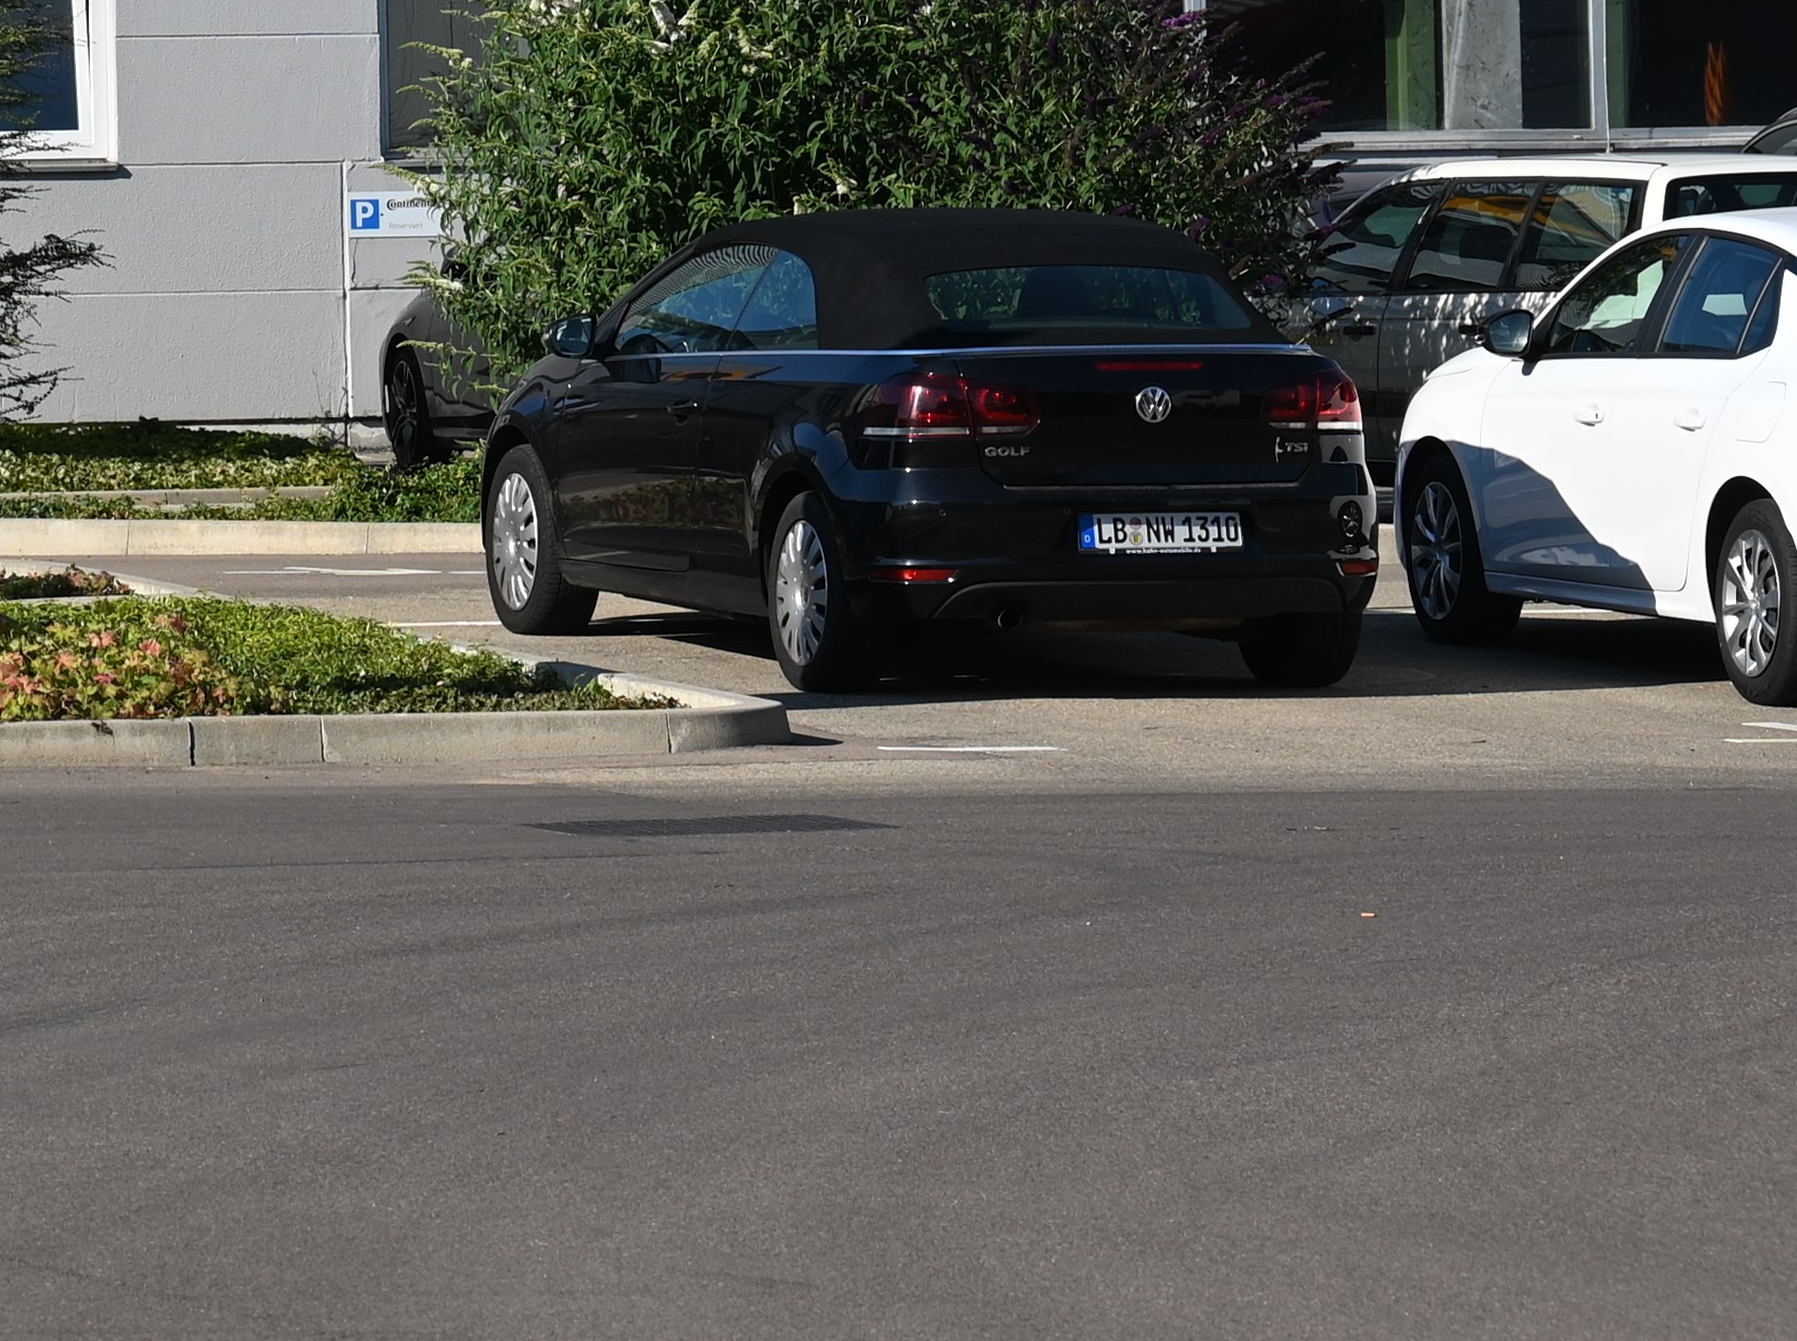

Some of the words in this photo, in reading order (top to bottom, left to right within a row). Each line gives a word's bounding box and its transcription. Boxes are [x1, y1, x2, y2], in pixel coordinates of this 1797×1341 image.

[356, 201, 374, 228] P
[984, 446, 1032, 457] GOLF
[1285, 441, 1308, 452] TSI
[1097, 517, 1128, 544] LB
[1145, 517, 1175, 544] NW
[1182, 516, 1239, 543] 1310
